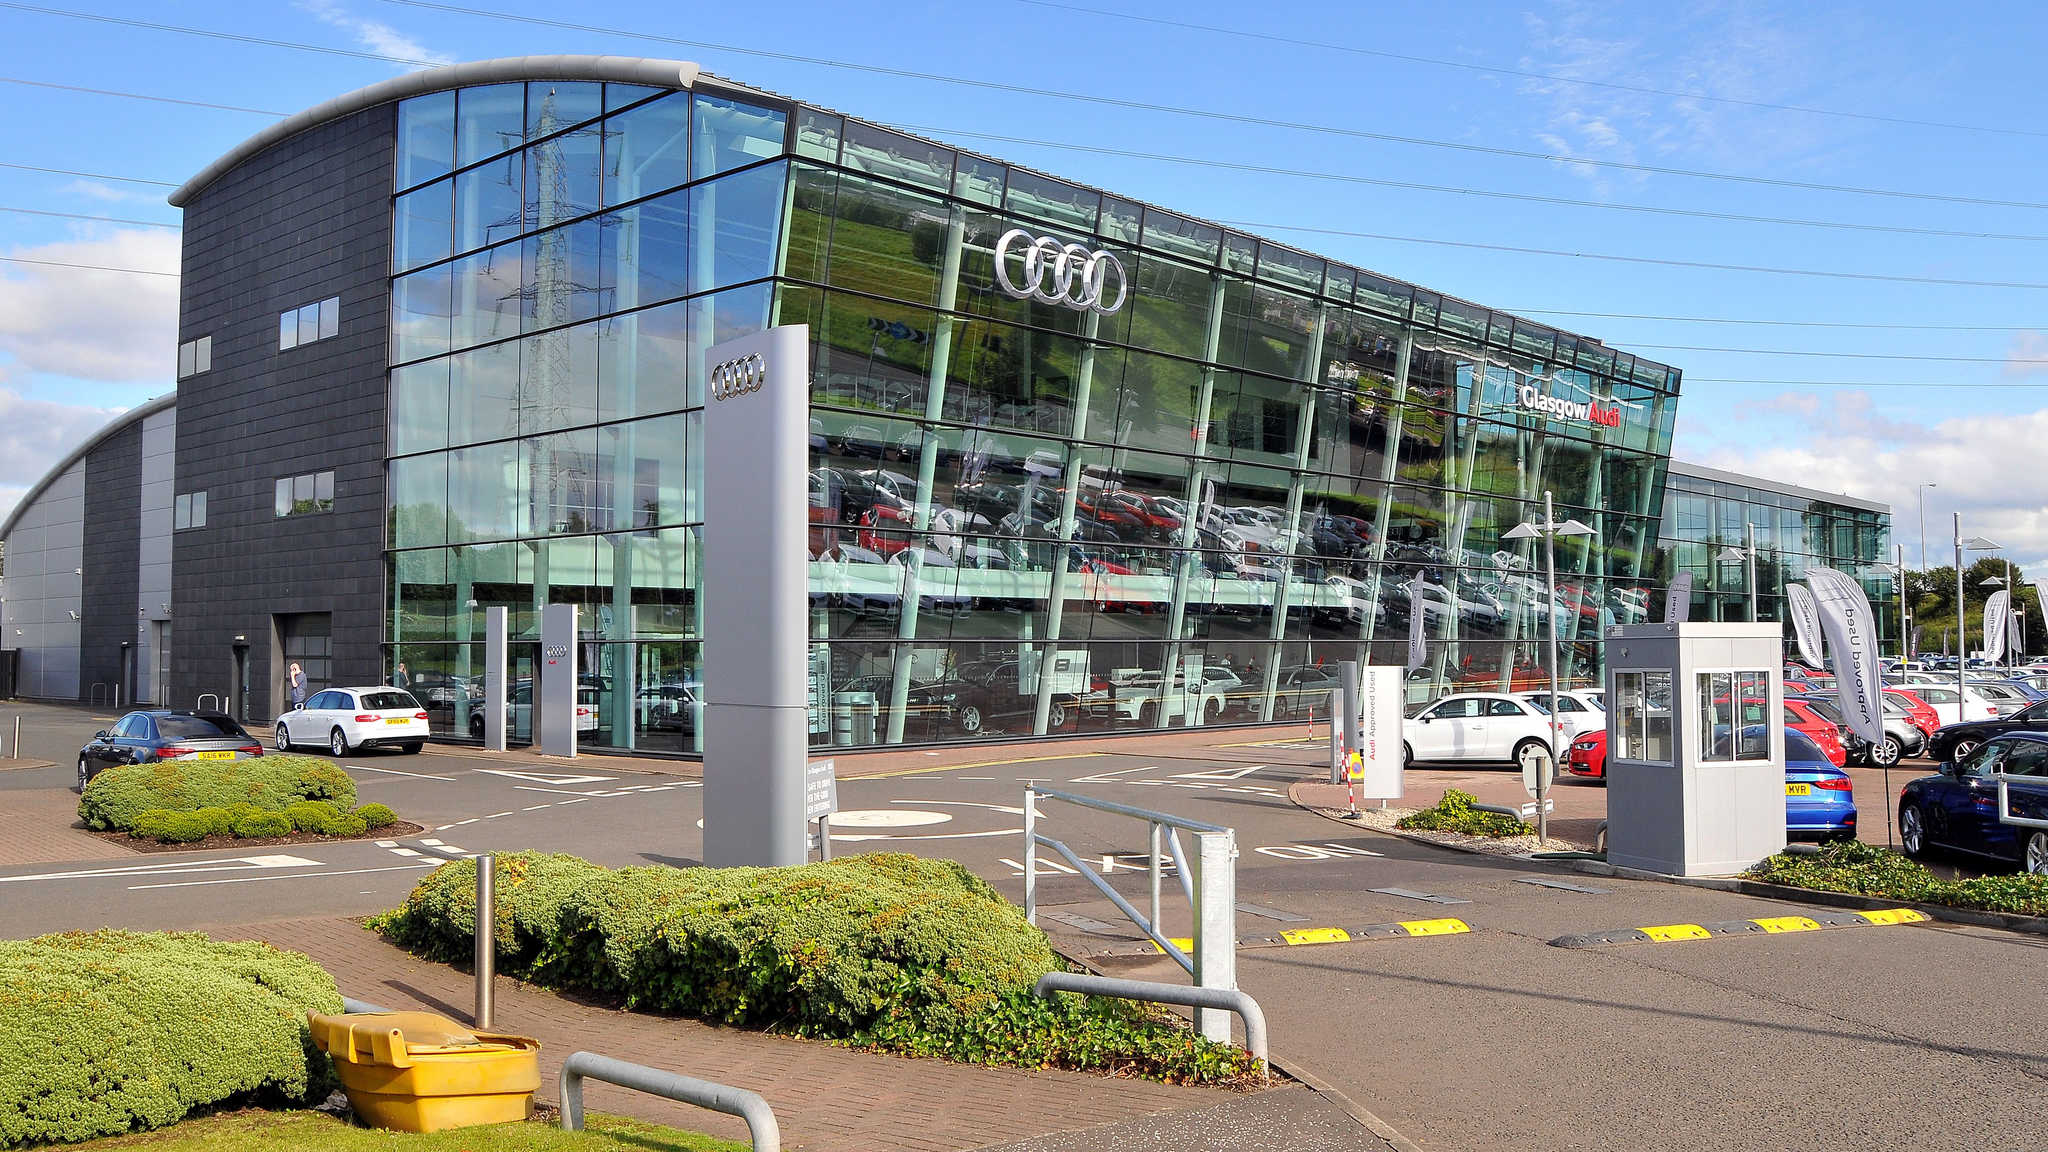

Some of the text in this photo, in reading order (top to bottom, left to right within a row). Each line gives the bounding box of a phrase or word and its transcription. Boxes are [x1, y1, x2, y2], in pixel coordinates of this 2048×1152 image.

[1522, 385, 1620, 428] Glasgow Audi
[1369, 695, 1377, 738] Approved
[1788, 785, 1807, 794] MVR
